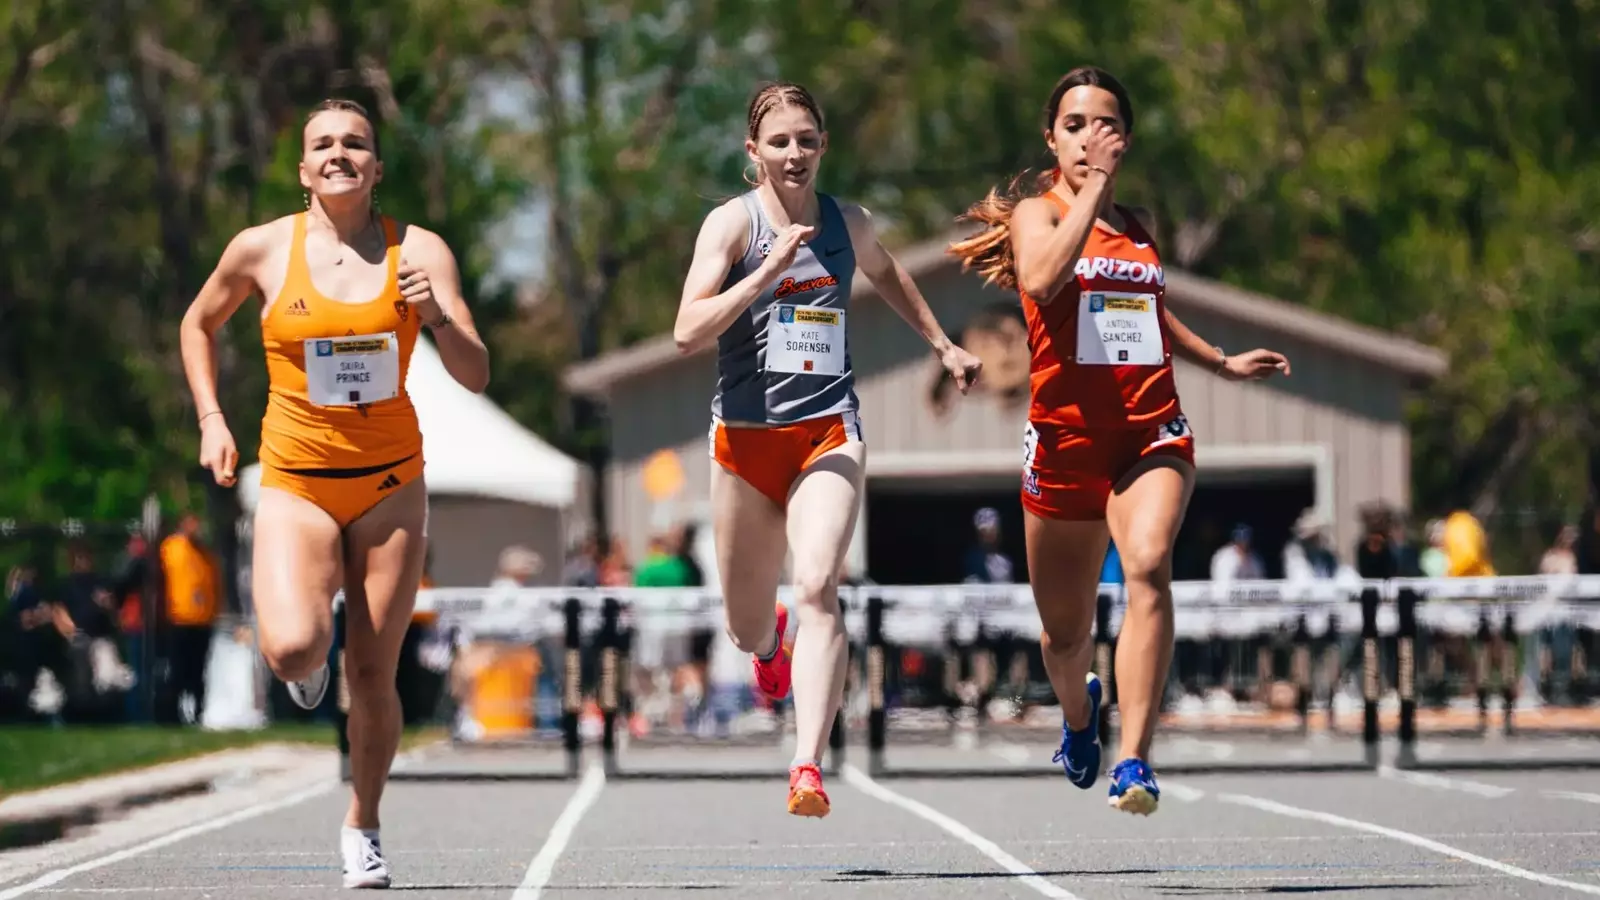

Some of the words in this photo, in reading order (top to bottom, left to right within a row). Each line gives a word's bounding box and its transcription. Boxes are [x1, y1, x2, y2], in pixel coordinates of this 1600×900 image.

[801, 331, 819, 341] KATE
[1103, 332, 1142, 343] SANCHEZ
[786, 341, 831, 353] SORENSEN
[336, 372, 371, 384] PRINCE
